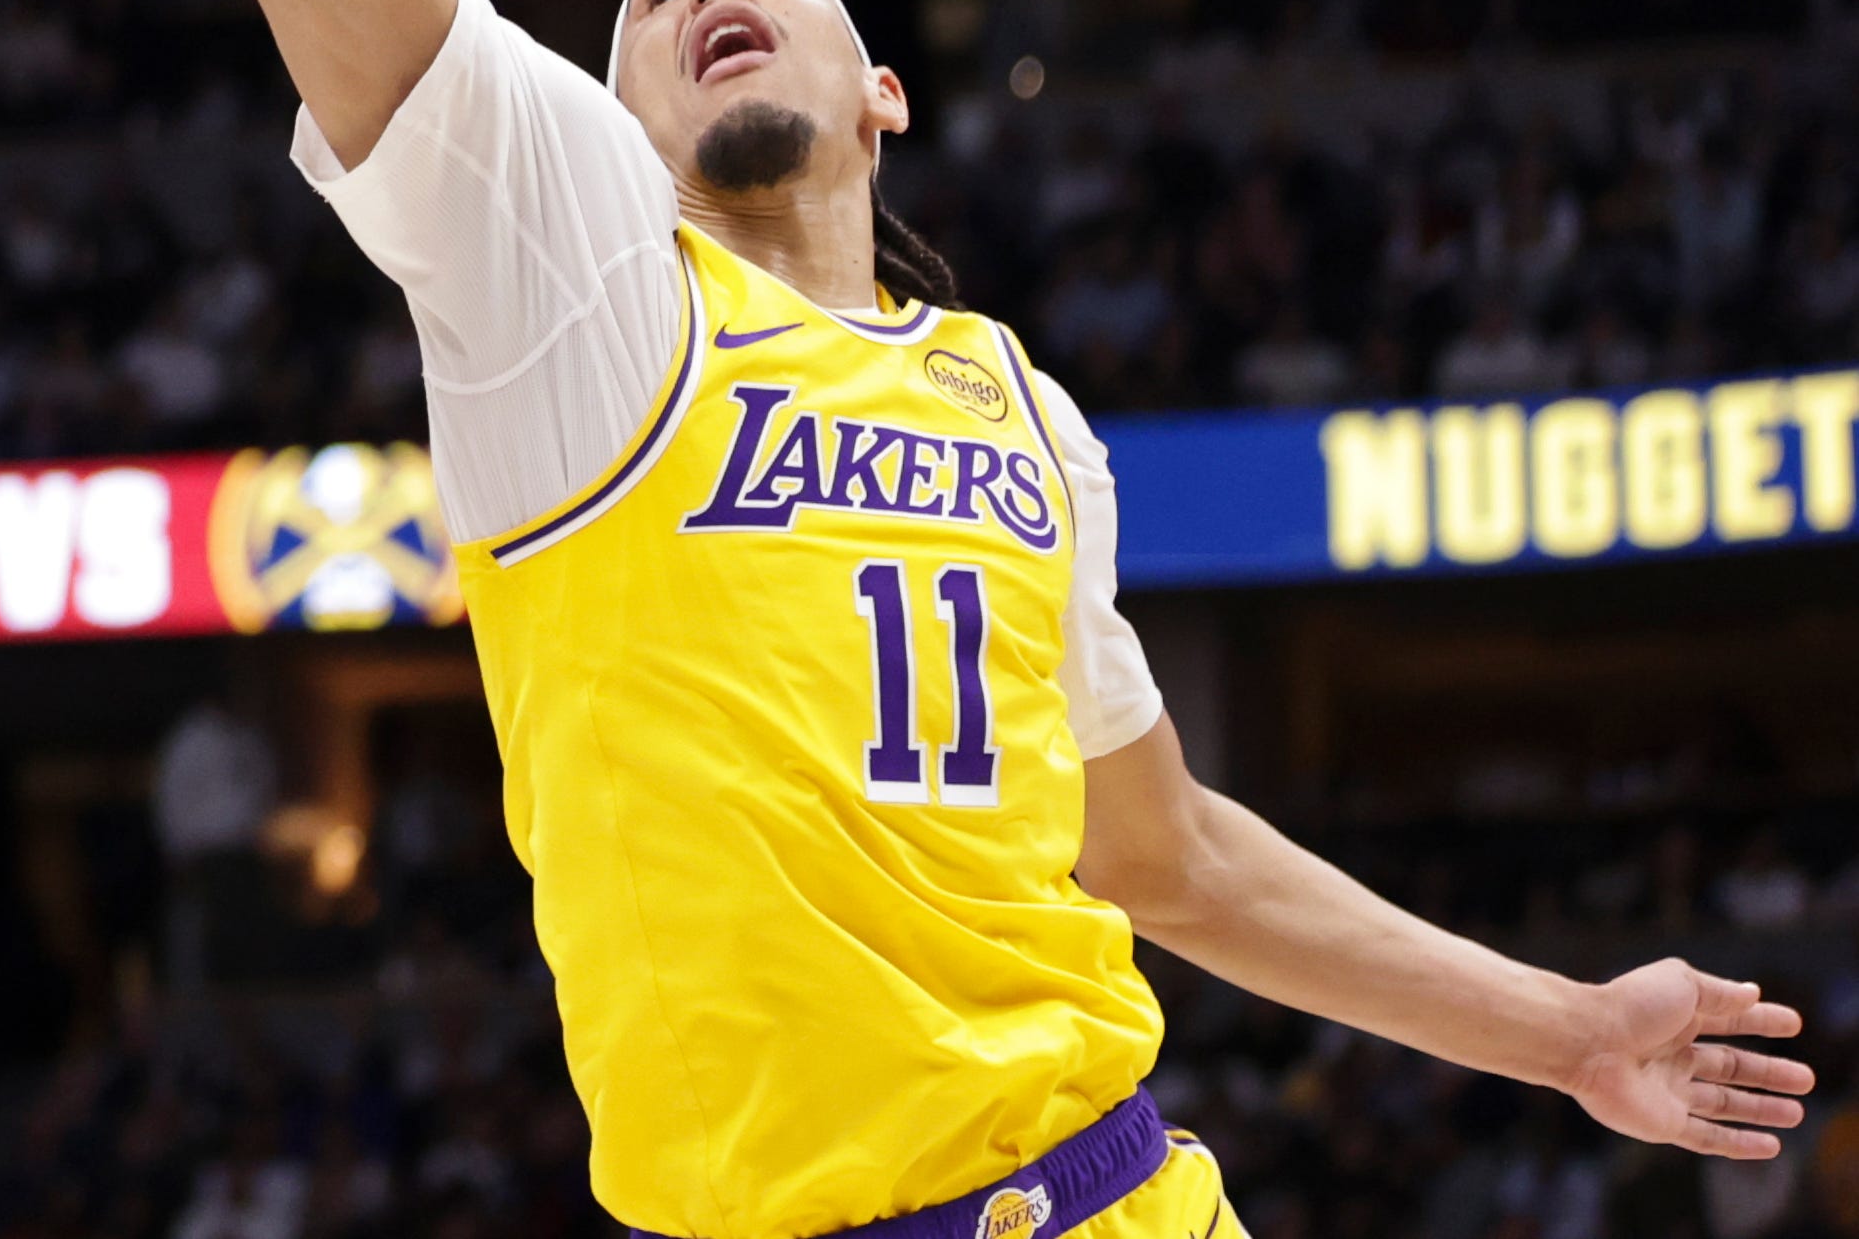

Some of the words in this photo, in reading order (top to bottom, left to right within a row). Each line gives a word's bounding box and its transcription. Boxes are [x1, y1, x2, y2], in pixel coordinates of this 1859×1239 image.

[677, 381, 1060, 556] LAKERS
[929, 363, 1001, 406] bibigo
[851, 558, 1003, 807] 11
